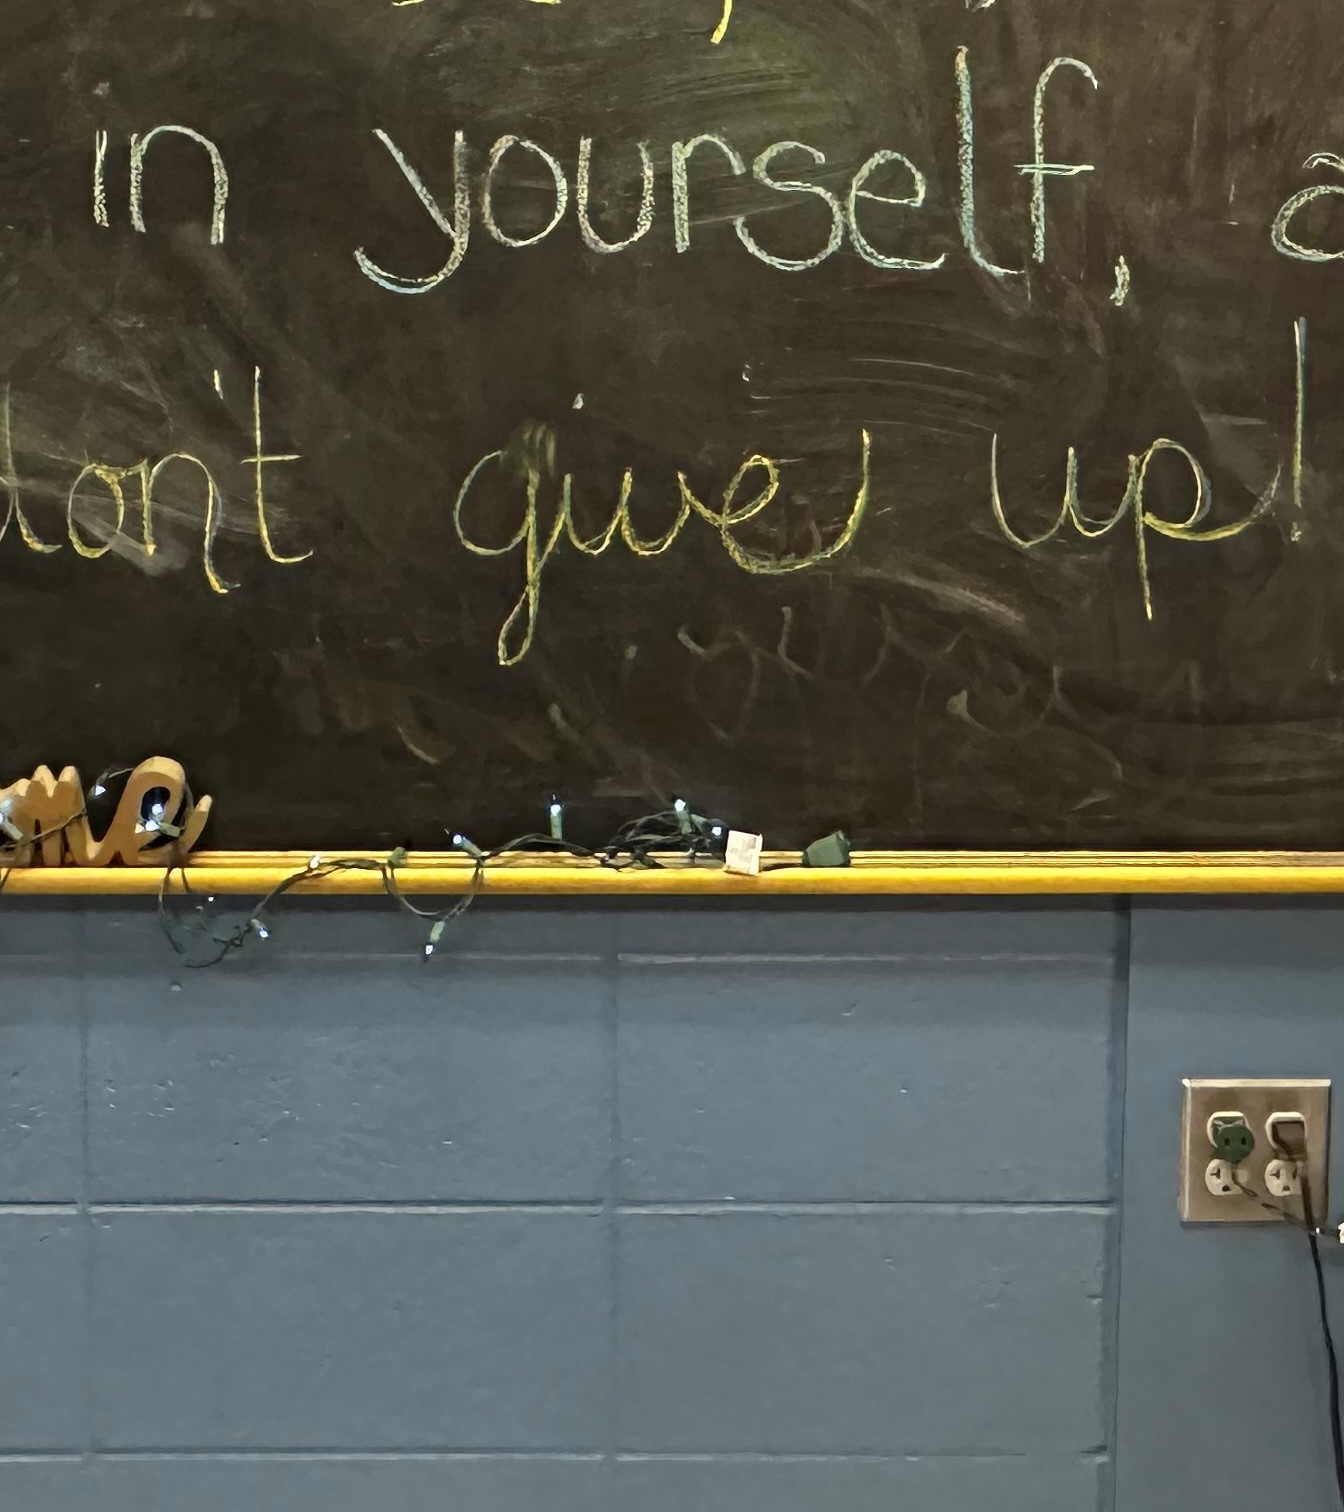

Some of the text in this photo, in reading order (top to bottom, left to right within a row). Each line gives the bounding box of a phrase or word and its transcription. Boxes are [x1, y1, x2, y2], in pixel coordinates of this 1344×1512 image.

[93, 85, 230, 246] in
[353, 44, 1131, 307] yourself,
[455, 392, 871, 666] give
[990, 315, 1308, 622] up!
